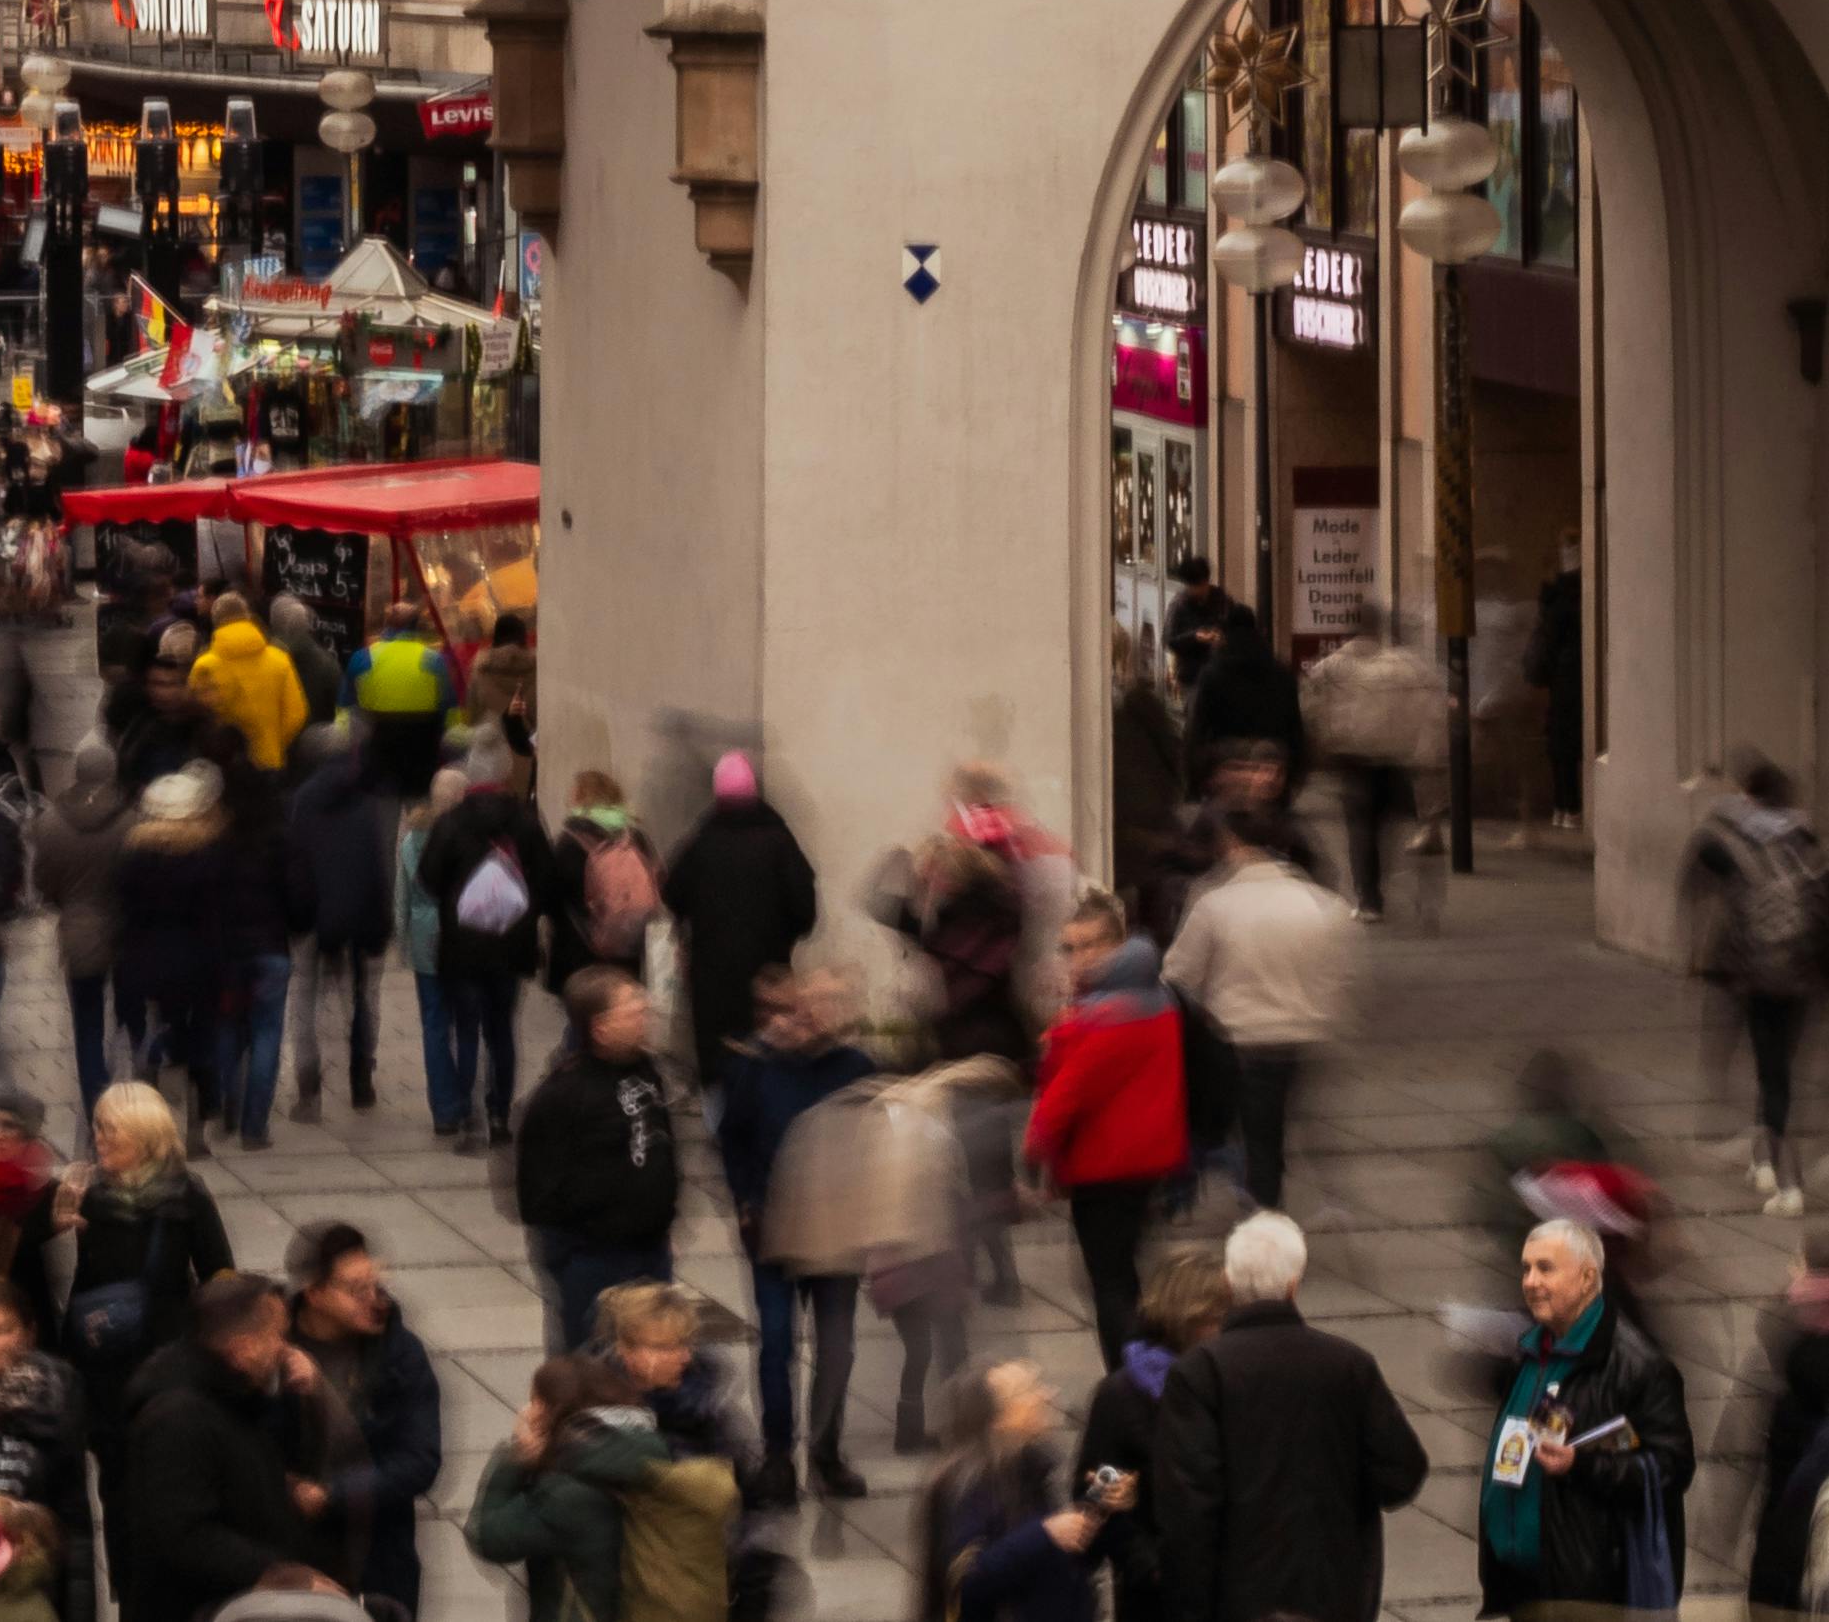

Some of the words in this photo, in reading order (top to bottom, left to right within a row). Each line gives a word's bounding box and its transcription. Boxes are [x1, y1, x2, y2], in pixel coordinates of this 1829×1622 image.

[1293, 246, 1356, 298] EDER
[1312, 518, 1361, 535] Mode
[1313, 550, 1360, 564] Leder
[1298, 568, 1375, 584] Lammfell
[1308, 588, 1364, 605] Daune
